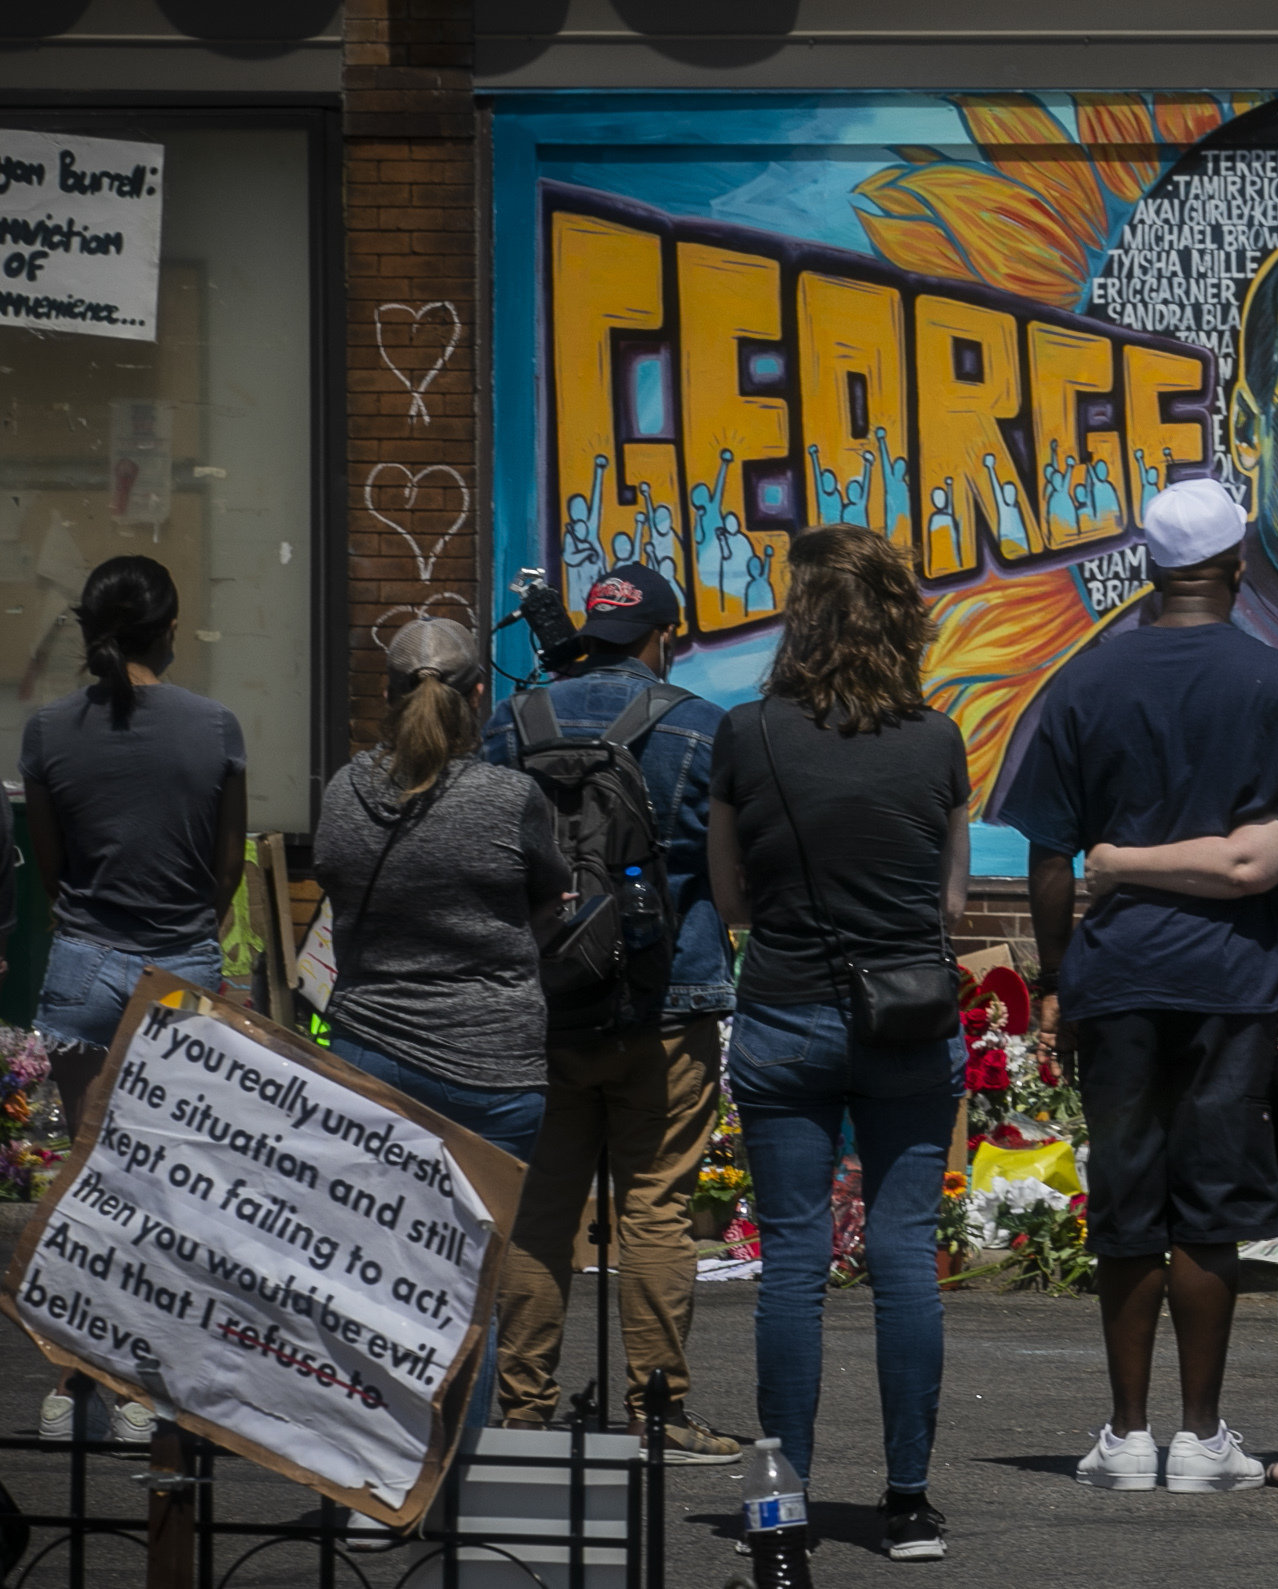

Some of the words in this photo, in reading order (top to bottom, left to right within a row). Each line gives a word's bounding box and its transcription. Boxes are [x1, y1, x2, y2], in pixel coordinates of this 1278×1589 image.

[1133, 200, 1181, 225] AKAI
[1184, 202, 1250, 226] GURLEY
[1172, 176, 1247, 201] TAMIR
[1107, 250, 1185, 280] TYISHA
[1123, 225, 1218, 250] MICHAEL
[1092, 277, 1142, 304] ERIC
[1143, 277, 1241, 304] GARNER
[1107, 303, 1197, 331] SANDRA
[548, 203, 1210, 640] GEORGE
[142, 1006, 174, 1042] If
[160, 1027, 226, 1073] you
[223, 1058, 320, 1129] really
[117, 1059, 167, 1110] the
[170, 1092, 320, 1190] situation
[328, 1177, 405, 1231] and
[406, 1216, 467, 1267] still
[100, 1107, 166, 1174] kept
[168, 1160, 215, 1202] on
[219, 1178, 341, 1272] failing
[344, 1244, 384, 1286] to
[391, 1275, 454, 1331] act,
[43, 1220, 116, 1282] And
[122, 1260, 194, 1320] that
[200, 1297, 216, 1330] I
[218, 1315, 338, 1390] refuse
[345, 1369, 386, 1411] to
[72, 1171, 138, 1228] then
[130, 1213, 199, 1264] you
[207, 1248, 318, 1320] would
[319, 1293, 362, 1345] be
[366, 1331, 437, 1387] evil.
